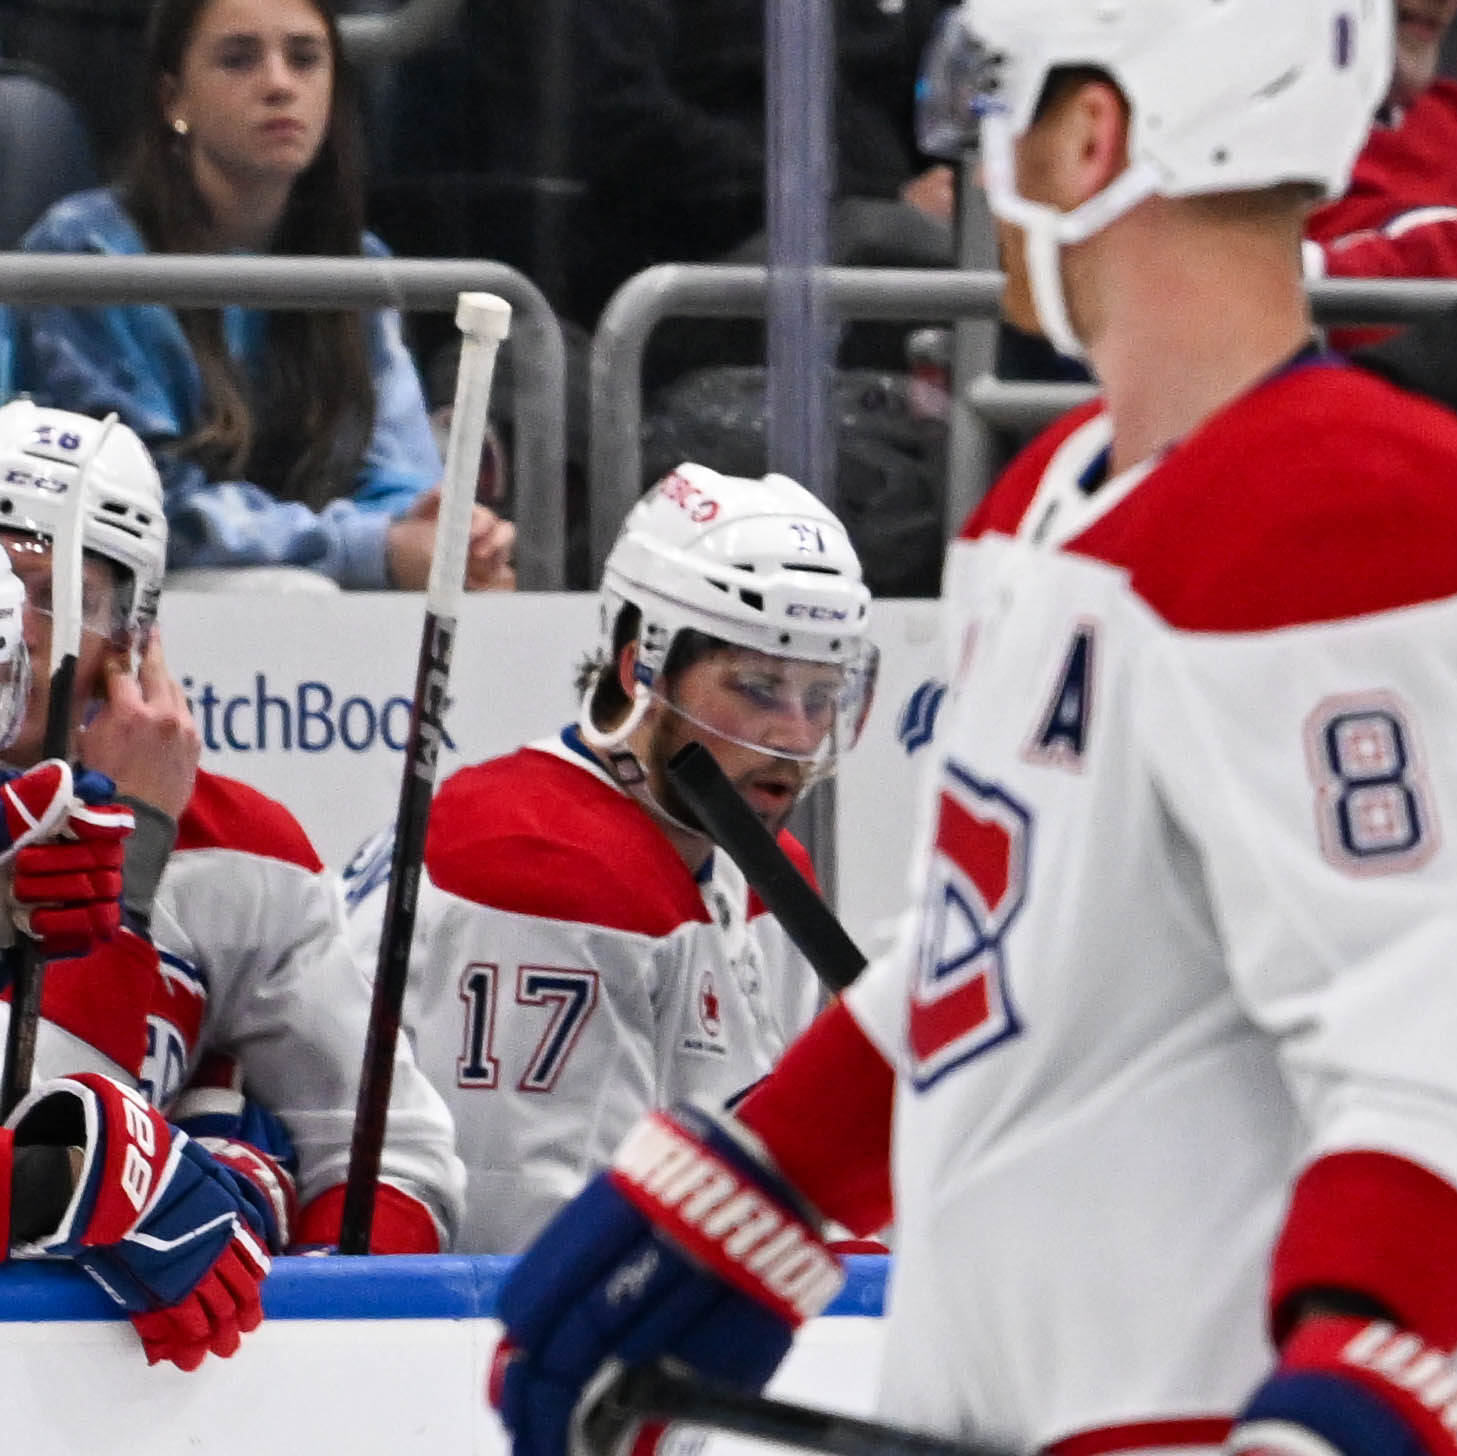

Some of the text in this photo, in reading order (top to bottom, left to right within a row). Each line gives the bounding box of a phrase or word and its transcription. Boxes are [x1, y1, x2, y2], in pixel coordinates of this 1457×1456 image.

[182, 671, 456, 752] itchBoo
[1022, 614, 1101, 774] A
[1303, 688, 1443, 880] 8
[457, 961, 599, 1092] 17
